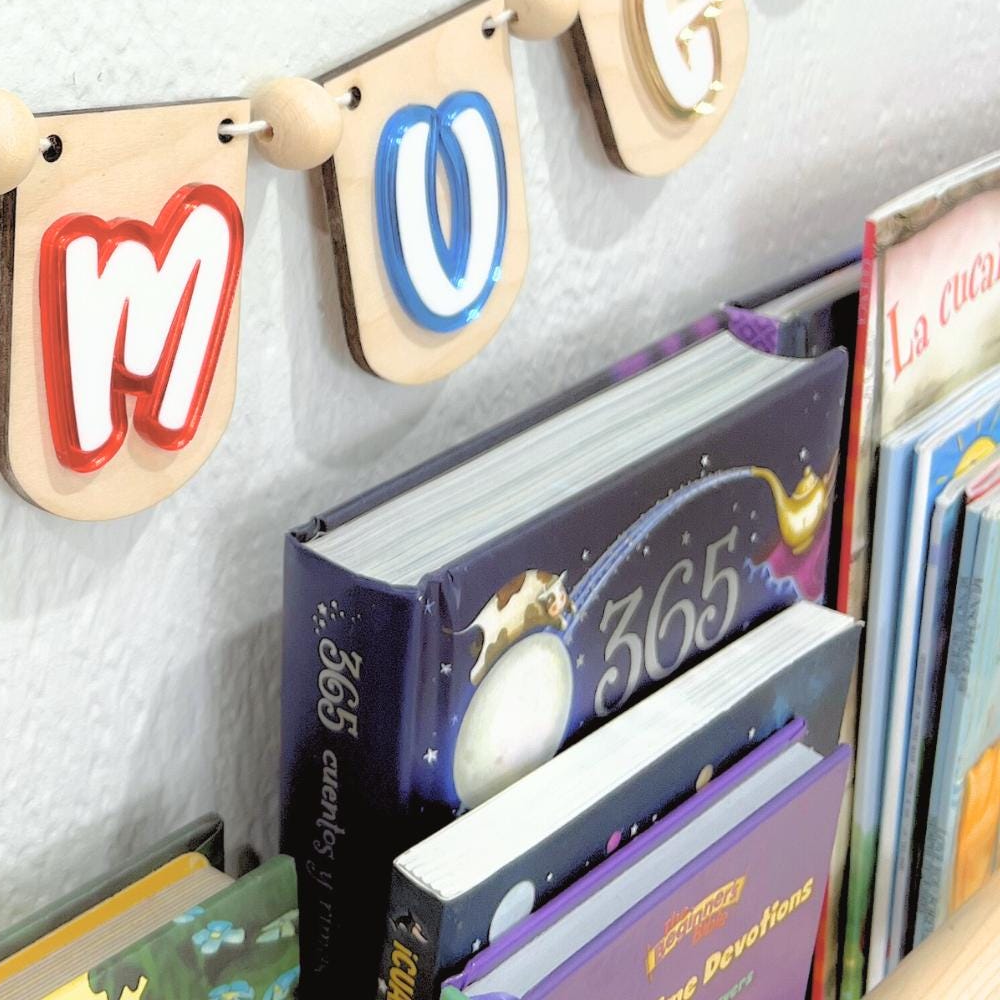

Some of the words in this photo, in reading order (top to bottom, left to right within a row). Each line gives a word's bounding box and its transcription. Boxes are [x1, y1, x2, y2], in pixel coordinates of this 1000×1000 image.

[886, 300, 929, 382] La
[594, 525, 739, 717] 365
[317, 637, 362, 739] 365
[313, 749, 346, 860] cuentos
[702, 877, 814, 985] Devotions
